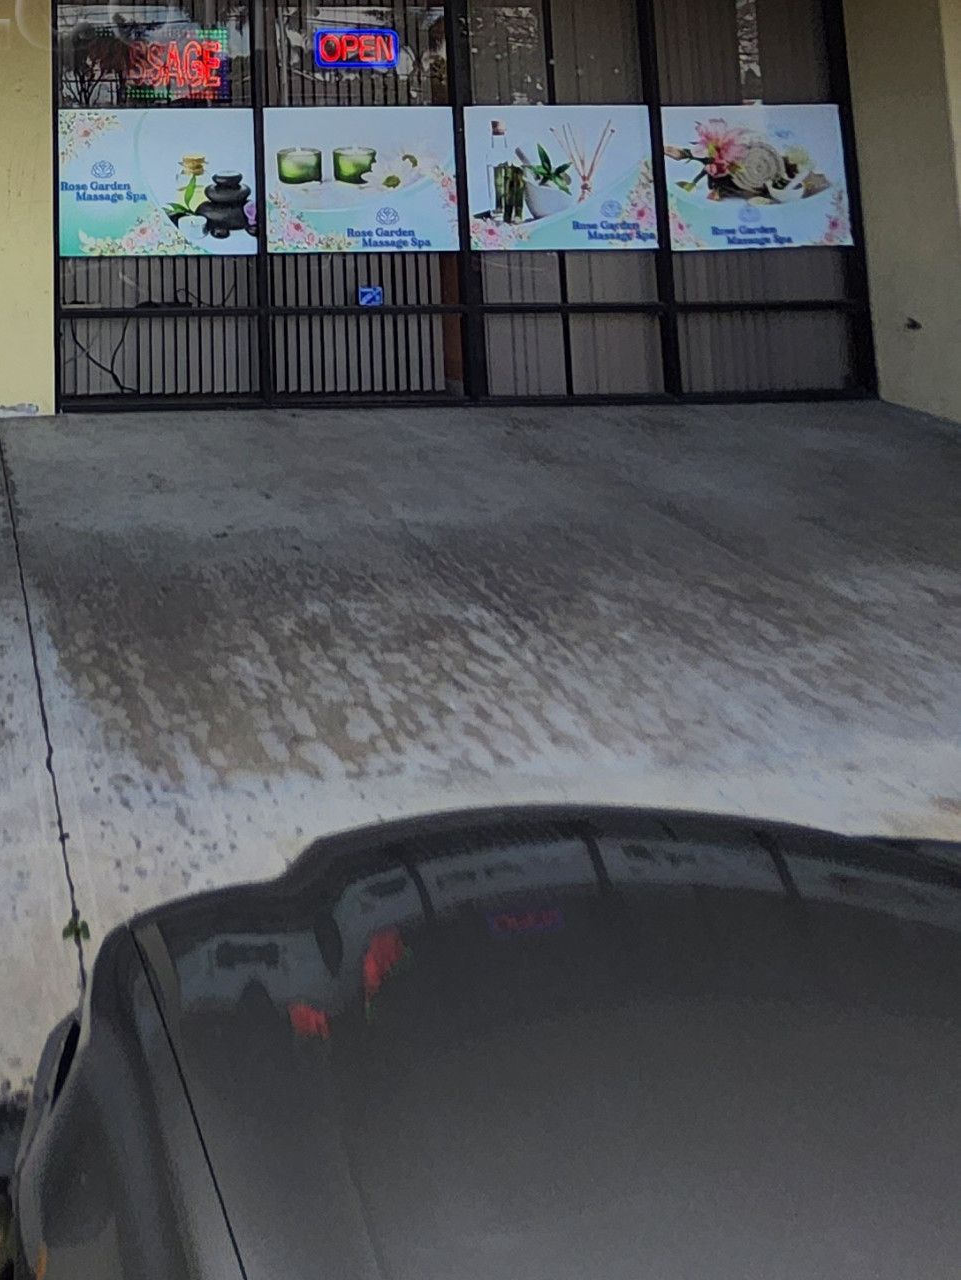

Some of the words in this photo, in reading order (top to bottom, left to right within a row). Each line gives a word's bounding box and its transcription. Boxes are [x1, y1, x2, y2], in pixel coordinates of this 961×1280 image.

[319, 34, 395, 63] OPEN
[127, 39, 222, 88] SSAGE
[60, 181, 88, 191] Rose
[90, 181, 131, 191] Garden
[76, 191, 124, 203] Massage
[125, 191, 148, 203] Spa
[347, 228, 374, 237] Rose
[375, 227, 415, 237] Garden
[361, 238, 409, 249] Massage
[411, 238, 432, 249] Spa
